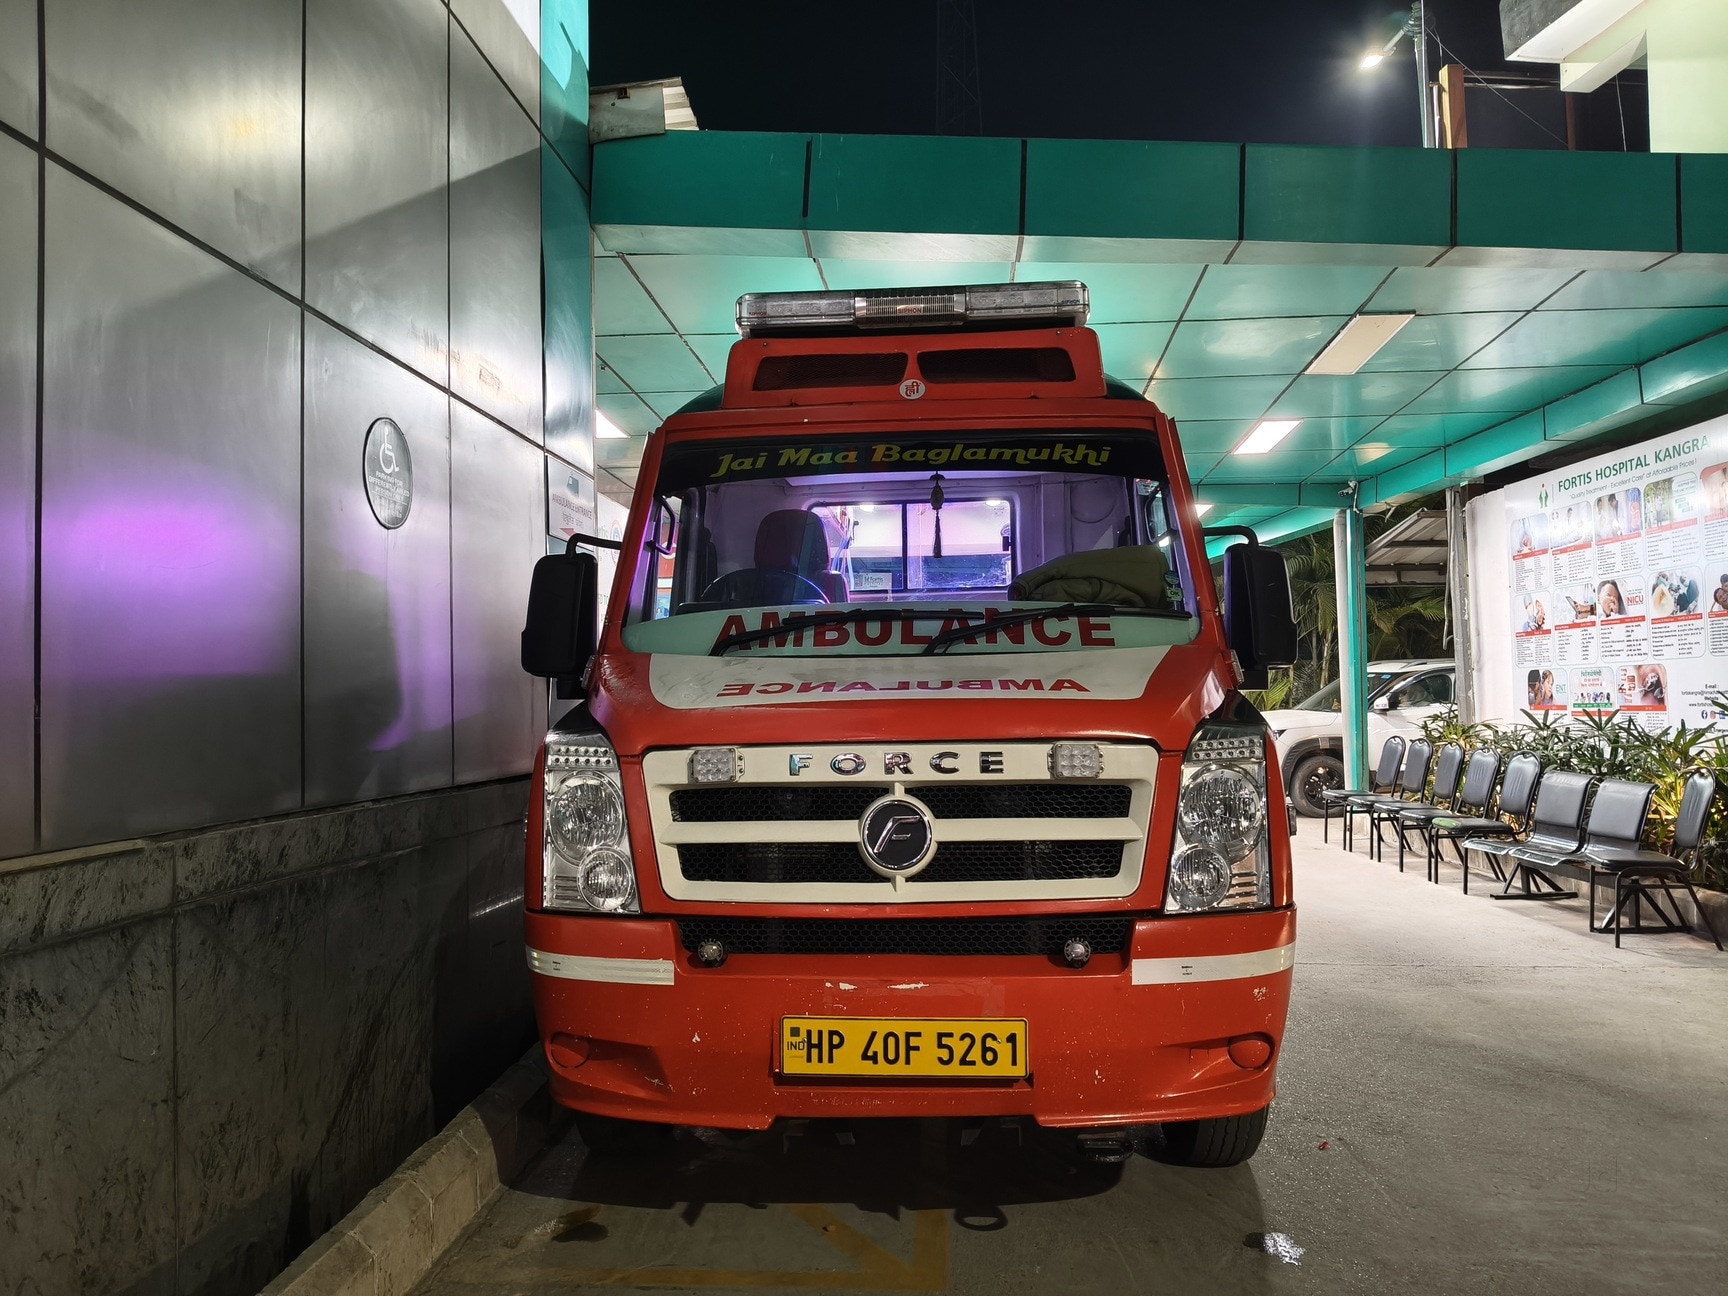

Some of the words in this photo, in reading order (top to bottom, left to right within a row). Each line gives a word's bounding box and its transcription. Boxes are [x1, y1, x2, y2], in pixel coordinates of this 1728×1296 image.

[710, 452, 767, 478] Jai
[778, 447, 858, 467] Maa
[870, 442, 1112, 466] Baglamukhi
[1558, 473, 1592, 493] FORTIS
[1595, 454, 1650, 481] HOSPITAL
[1654, 435, 1711, 464] KANGRA
[1610, 477, 1631, 488] Excellent
[1652, 464, 1679, 477] Affordable
[1627, 594, 1644, 604] NICU
[713, 607, 1117, 652] AMBULANCE
[788, 750, 1004, 777] FORCE
[786, 1041, 805, 1051] IND
[806, 1029, 846, 1064] HP
[861, 1030, 922, 1065] 40F
[936, 1032, 1018, 1067] 5261
